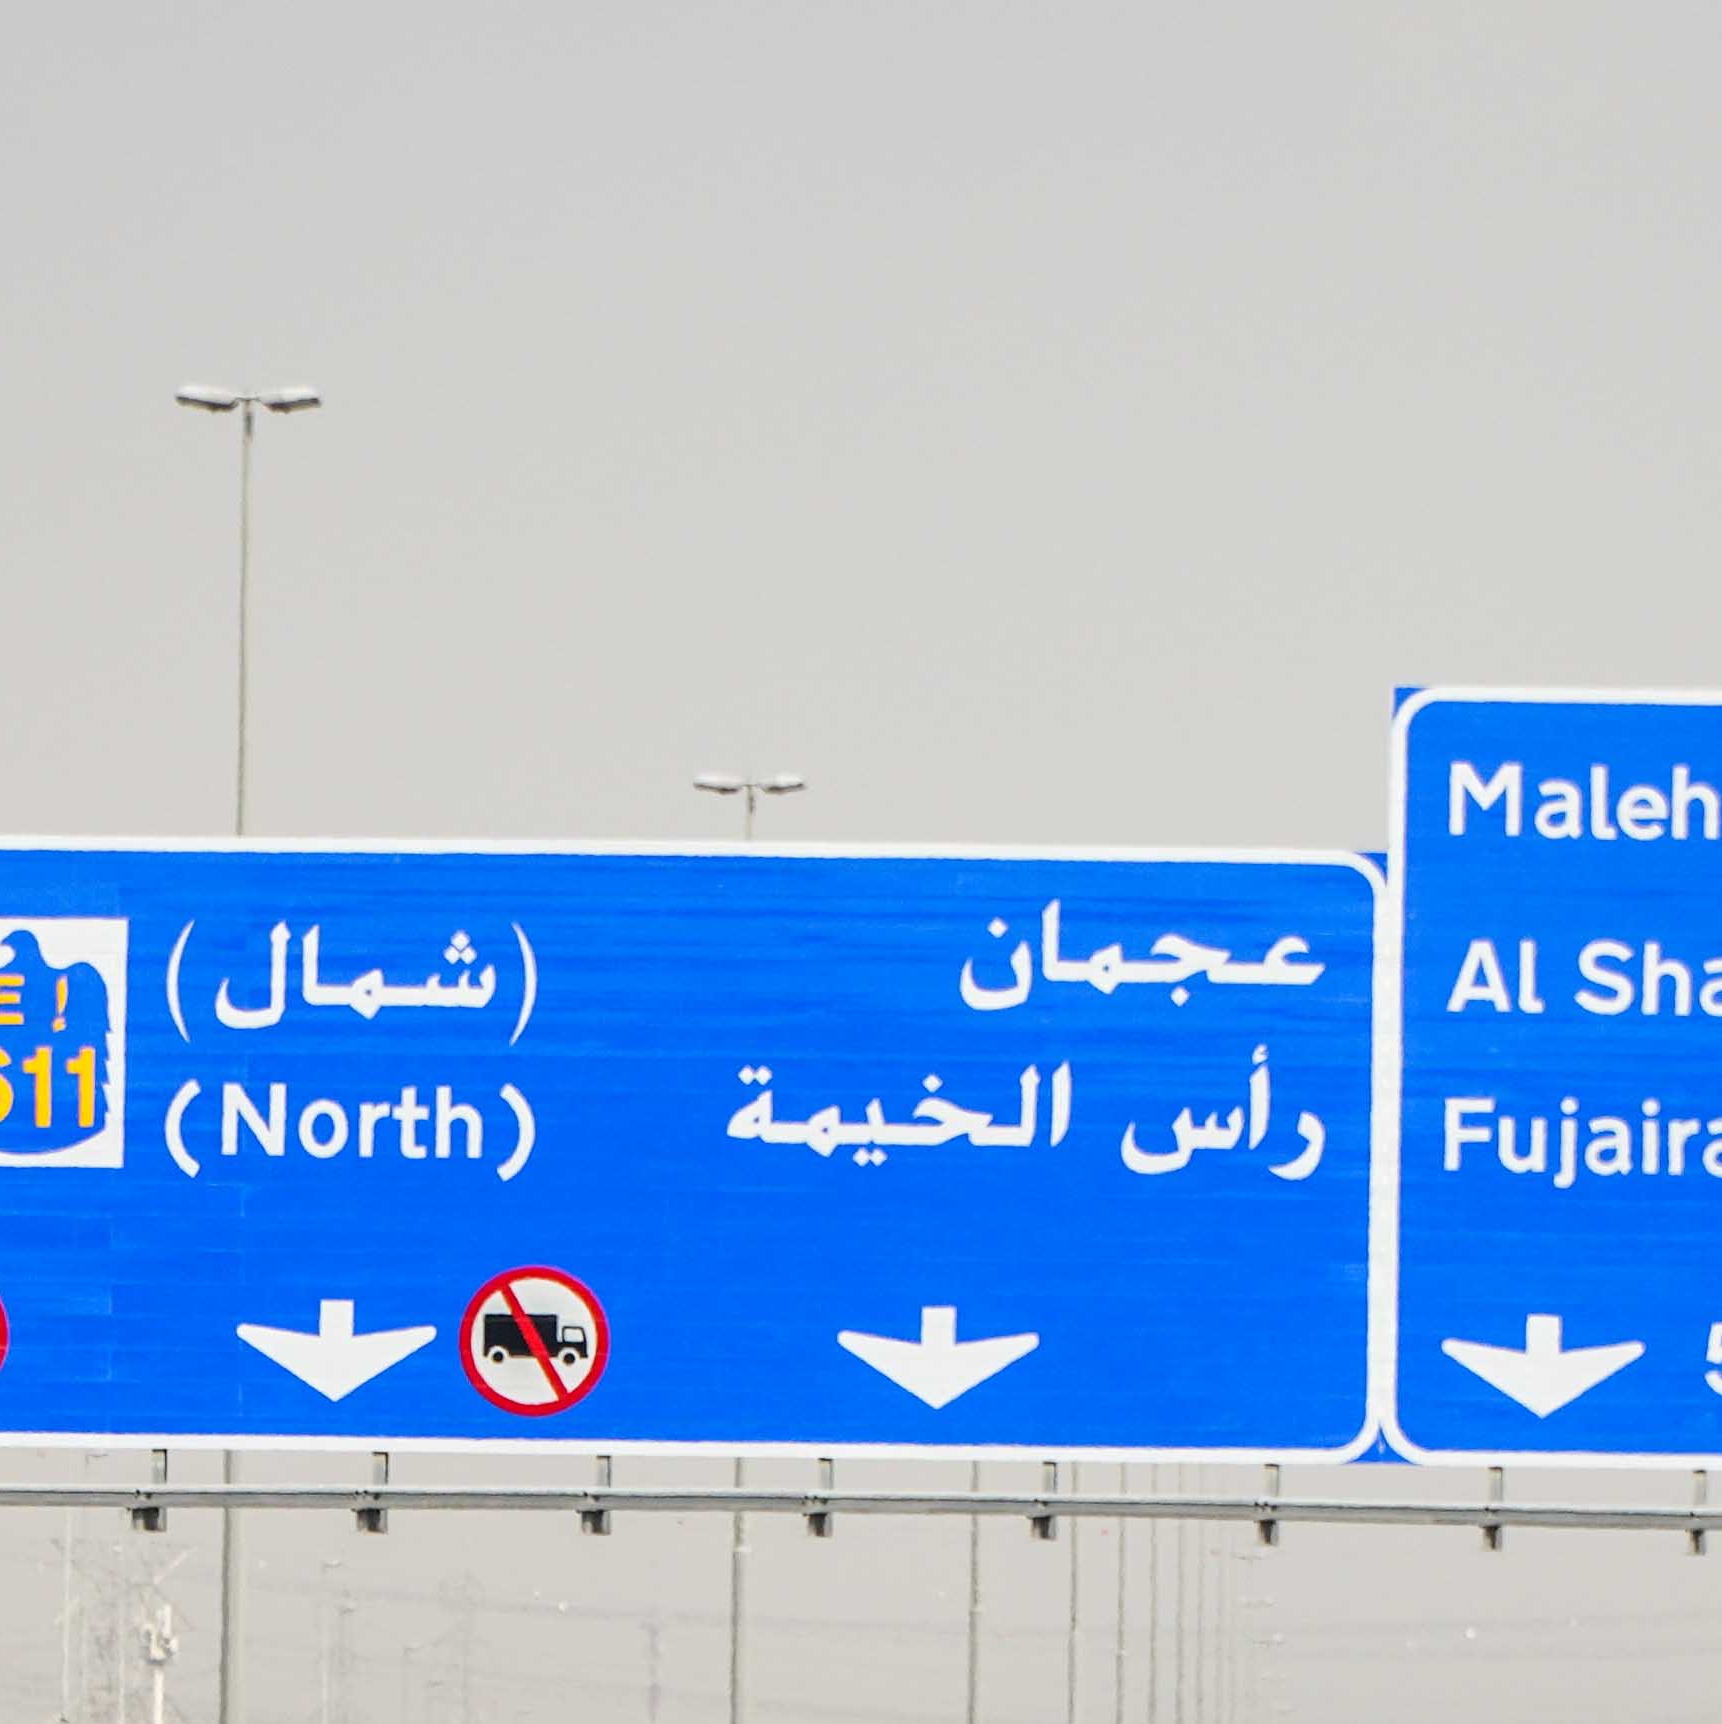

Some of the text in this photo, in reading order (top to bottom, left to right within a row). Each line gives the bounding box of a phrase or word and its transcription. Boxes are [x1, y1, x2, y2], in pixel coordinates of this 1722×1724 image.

[958, 898, 1327, 1012] عجمان
[1445, 937, 1546, 1016] Al
[162, 1077, 538, 1183] (North)
[725, 1042, 1327, 1182] رأس الخيمة
